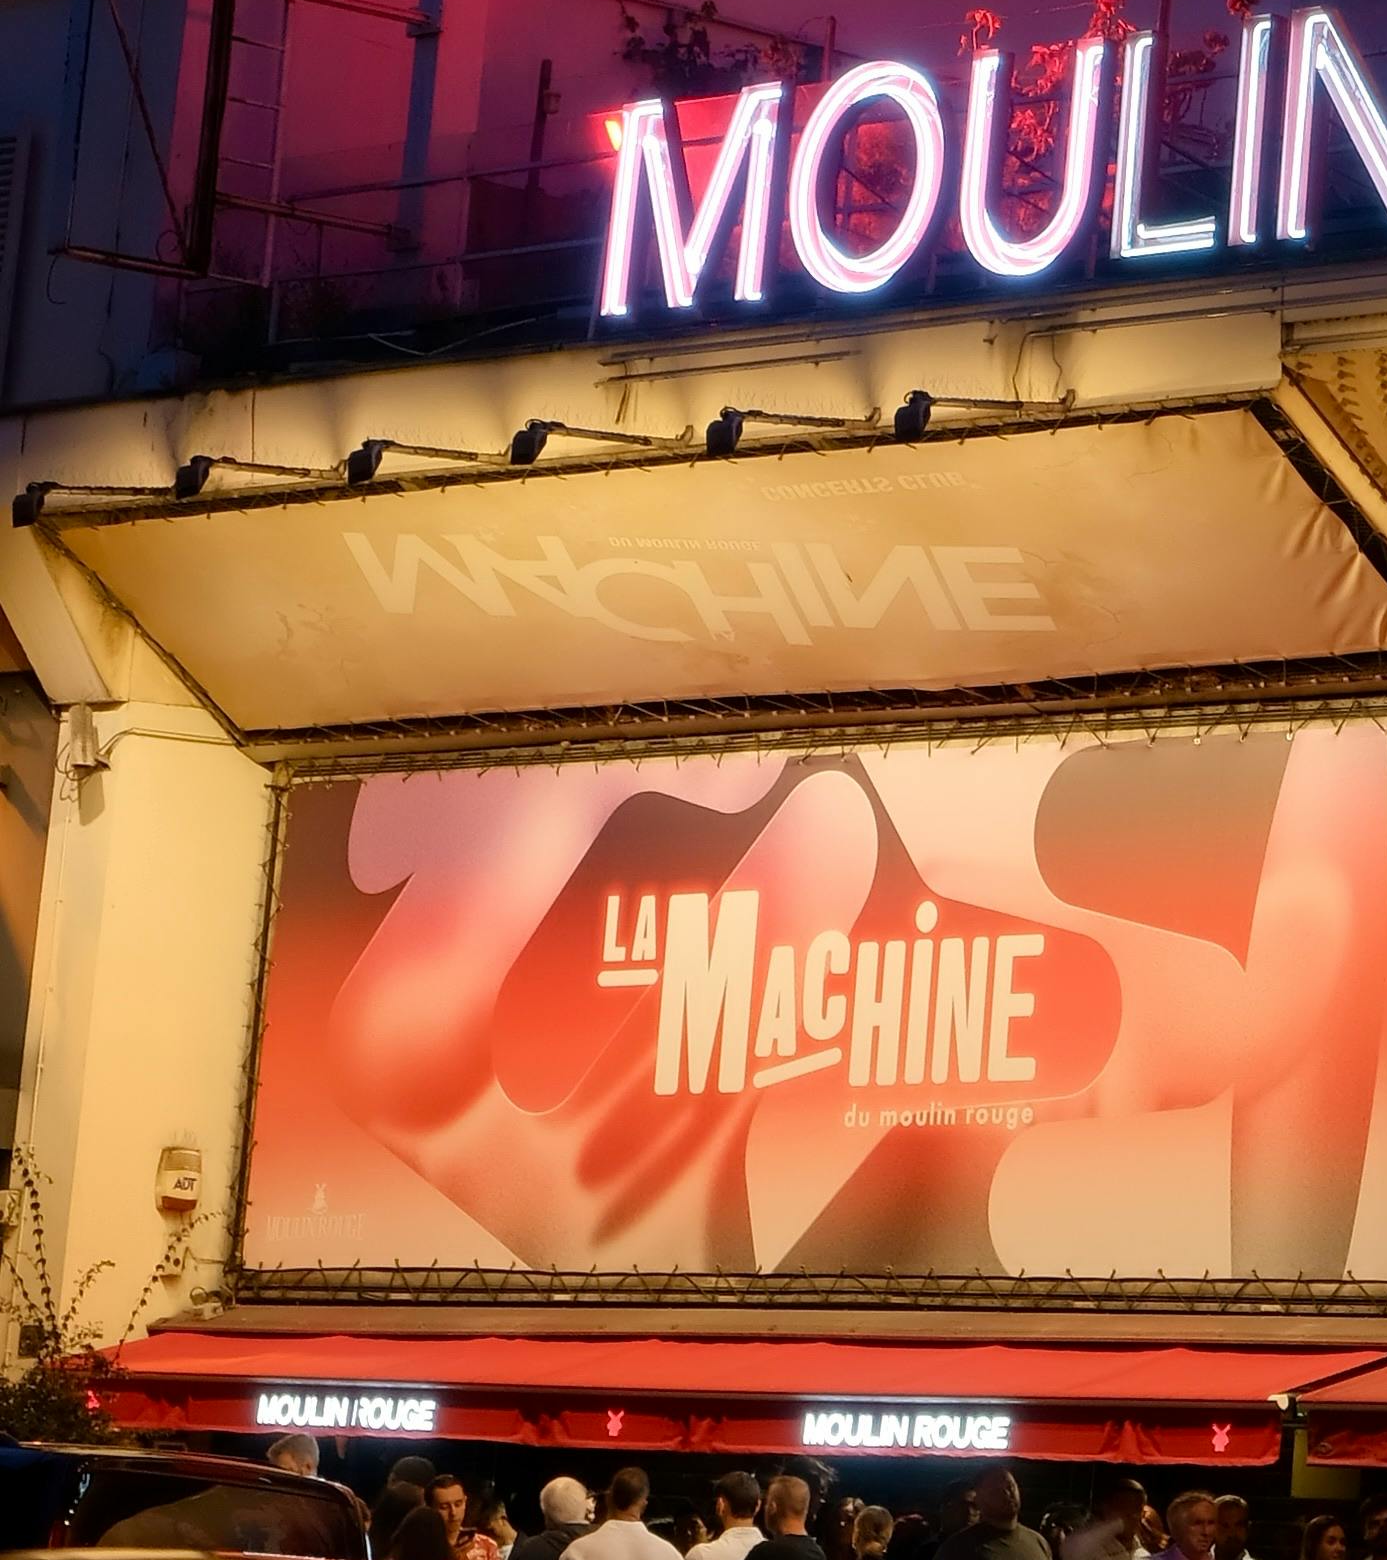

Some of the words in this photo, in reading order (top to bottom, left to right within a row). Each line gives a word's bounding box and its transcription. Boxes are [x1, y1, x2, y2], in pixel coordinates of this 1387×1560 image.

[603, 895, 657, 962] LA
[844, 1103, 870, 1128] du
[879, 1102, 956, 1128] moulin
[965, 1106, 1035, 1130] rouge
[173, 1177, 197, 1191] ADT
[256, 1394, 350, 1428] MOULIN
[351, 1397, 437, 1431] ROUGE
[802, 1413, 909, 1447] MOULIN
[913, 1415, 1011, 1449] ROUGE
